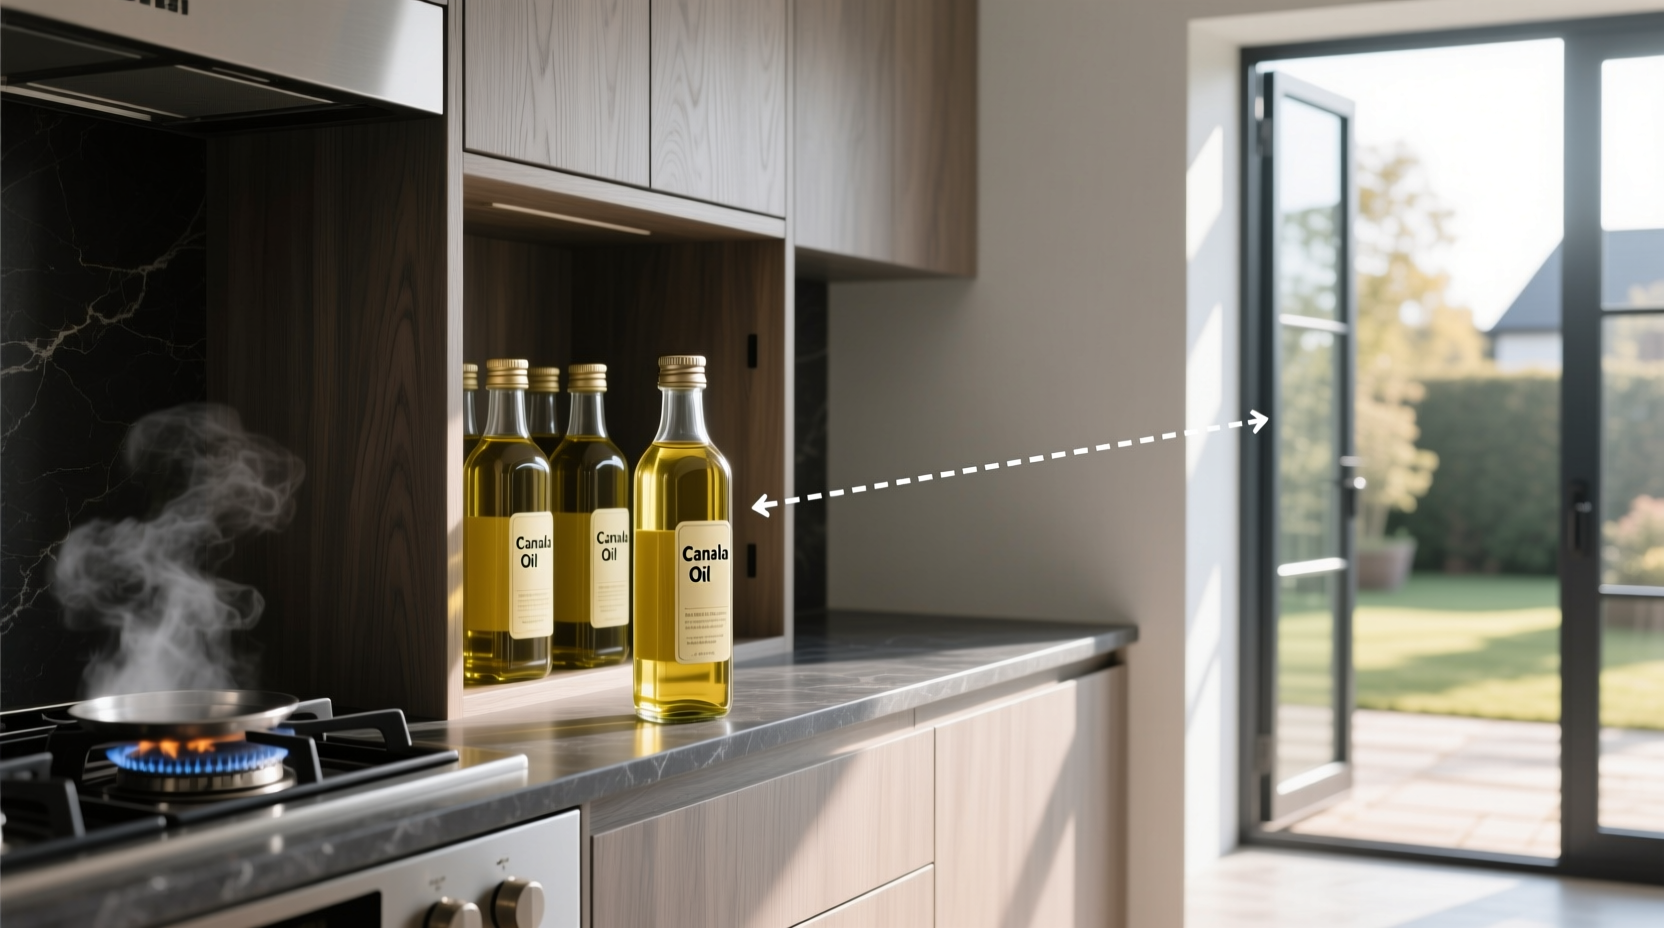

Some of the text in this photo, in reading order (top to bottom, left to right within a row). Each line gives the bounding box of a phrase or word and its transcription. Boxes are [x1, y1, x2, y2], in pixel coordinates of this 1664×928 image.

[520, 553, 537, 568] Oil
[601, 547, 617, 562] Oil
[682, 543, 729, 562] Canala
[689, 565, 711, 583] Oil
